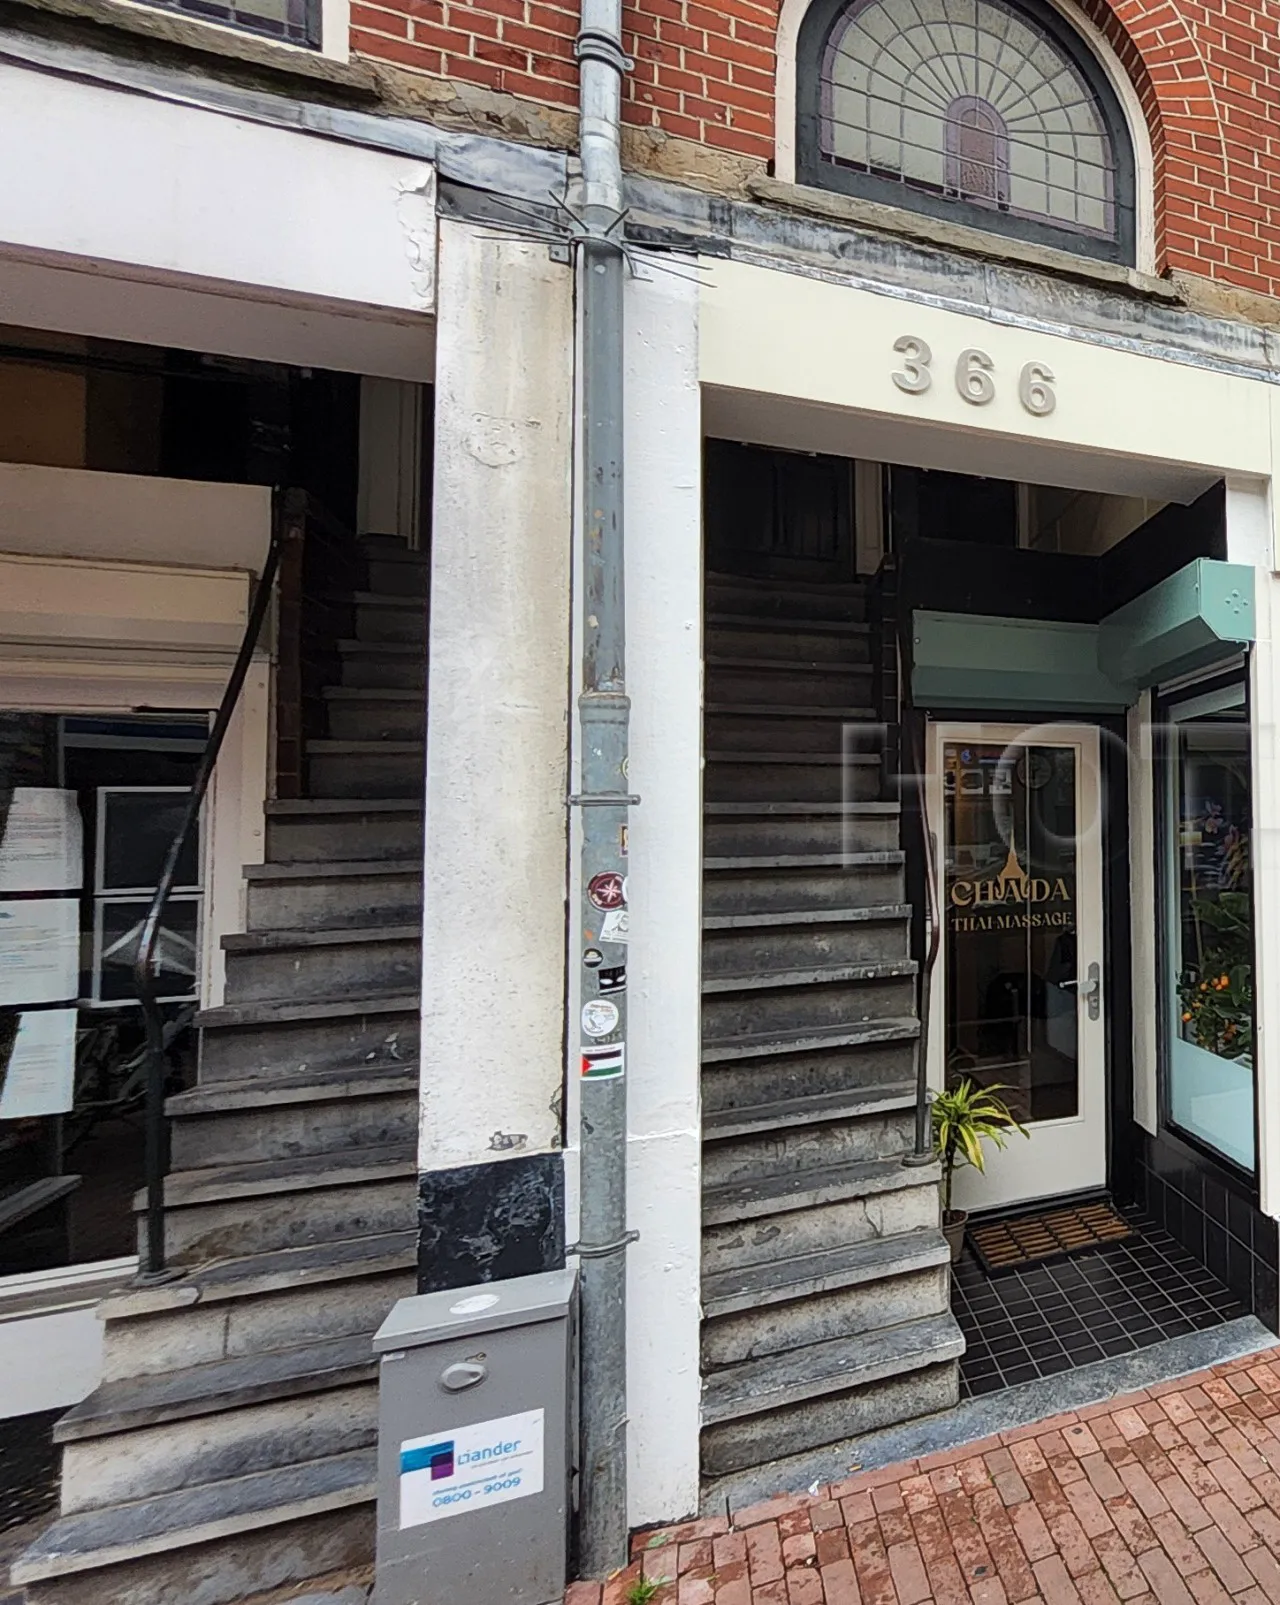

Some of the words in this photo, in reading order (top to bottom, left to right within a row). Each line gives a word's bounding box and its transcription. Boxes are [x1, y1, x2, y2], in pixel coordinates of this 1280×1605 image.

[891, 335, 1057, 416] 366
[951, 877, 1071, 907] CHADA
[951, 916, 994, 932] THAI
[997, 911, 1073, 930] MASSAGE
[457, 1440, 522, 1466] Liander
[431, 1489, 472, 1508] 0800
[483, 1476, 522, 1496] 9009
